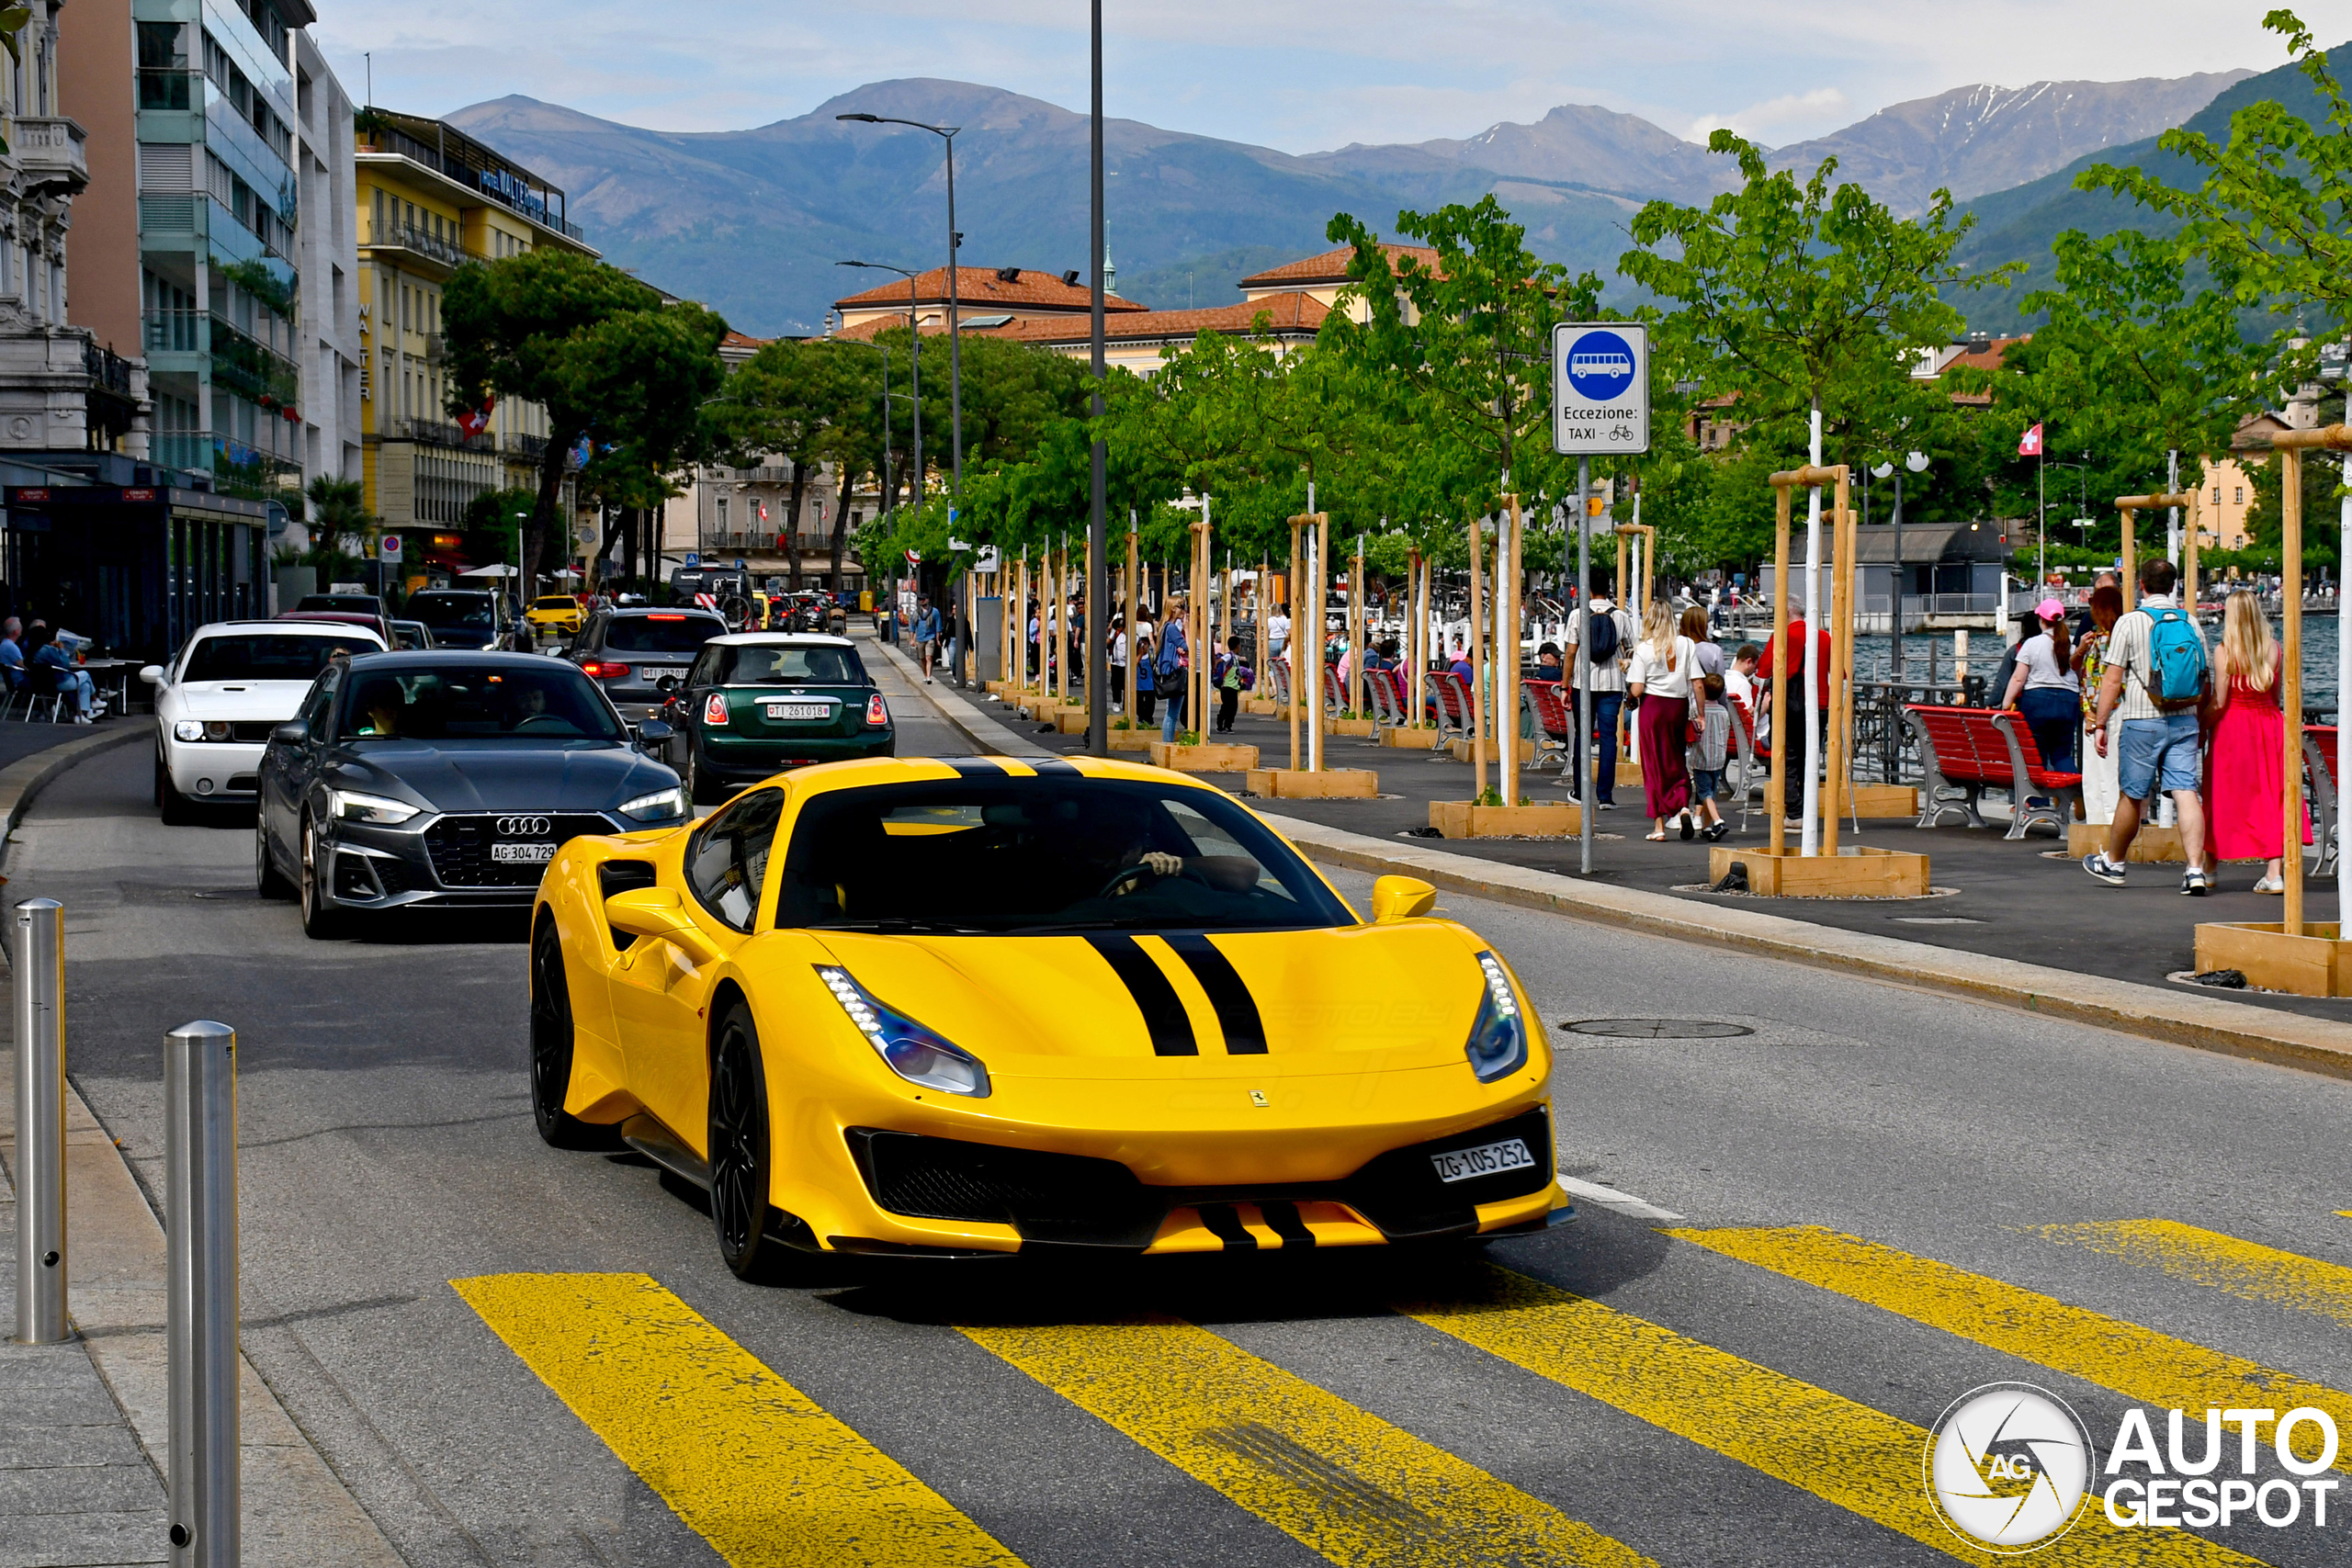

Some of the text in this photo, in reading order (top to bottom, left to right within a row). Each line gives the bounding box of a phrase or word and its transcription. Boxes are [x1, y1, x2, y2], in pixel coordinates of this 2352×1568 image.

[497, 169, 529, 205] WALTER
[1564, 405, 1638, 420] Eccezione:
[1567, 427, 1596, 440] TAXI
